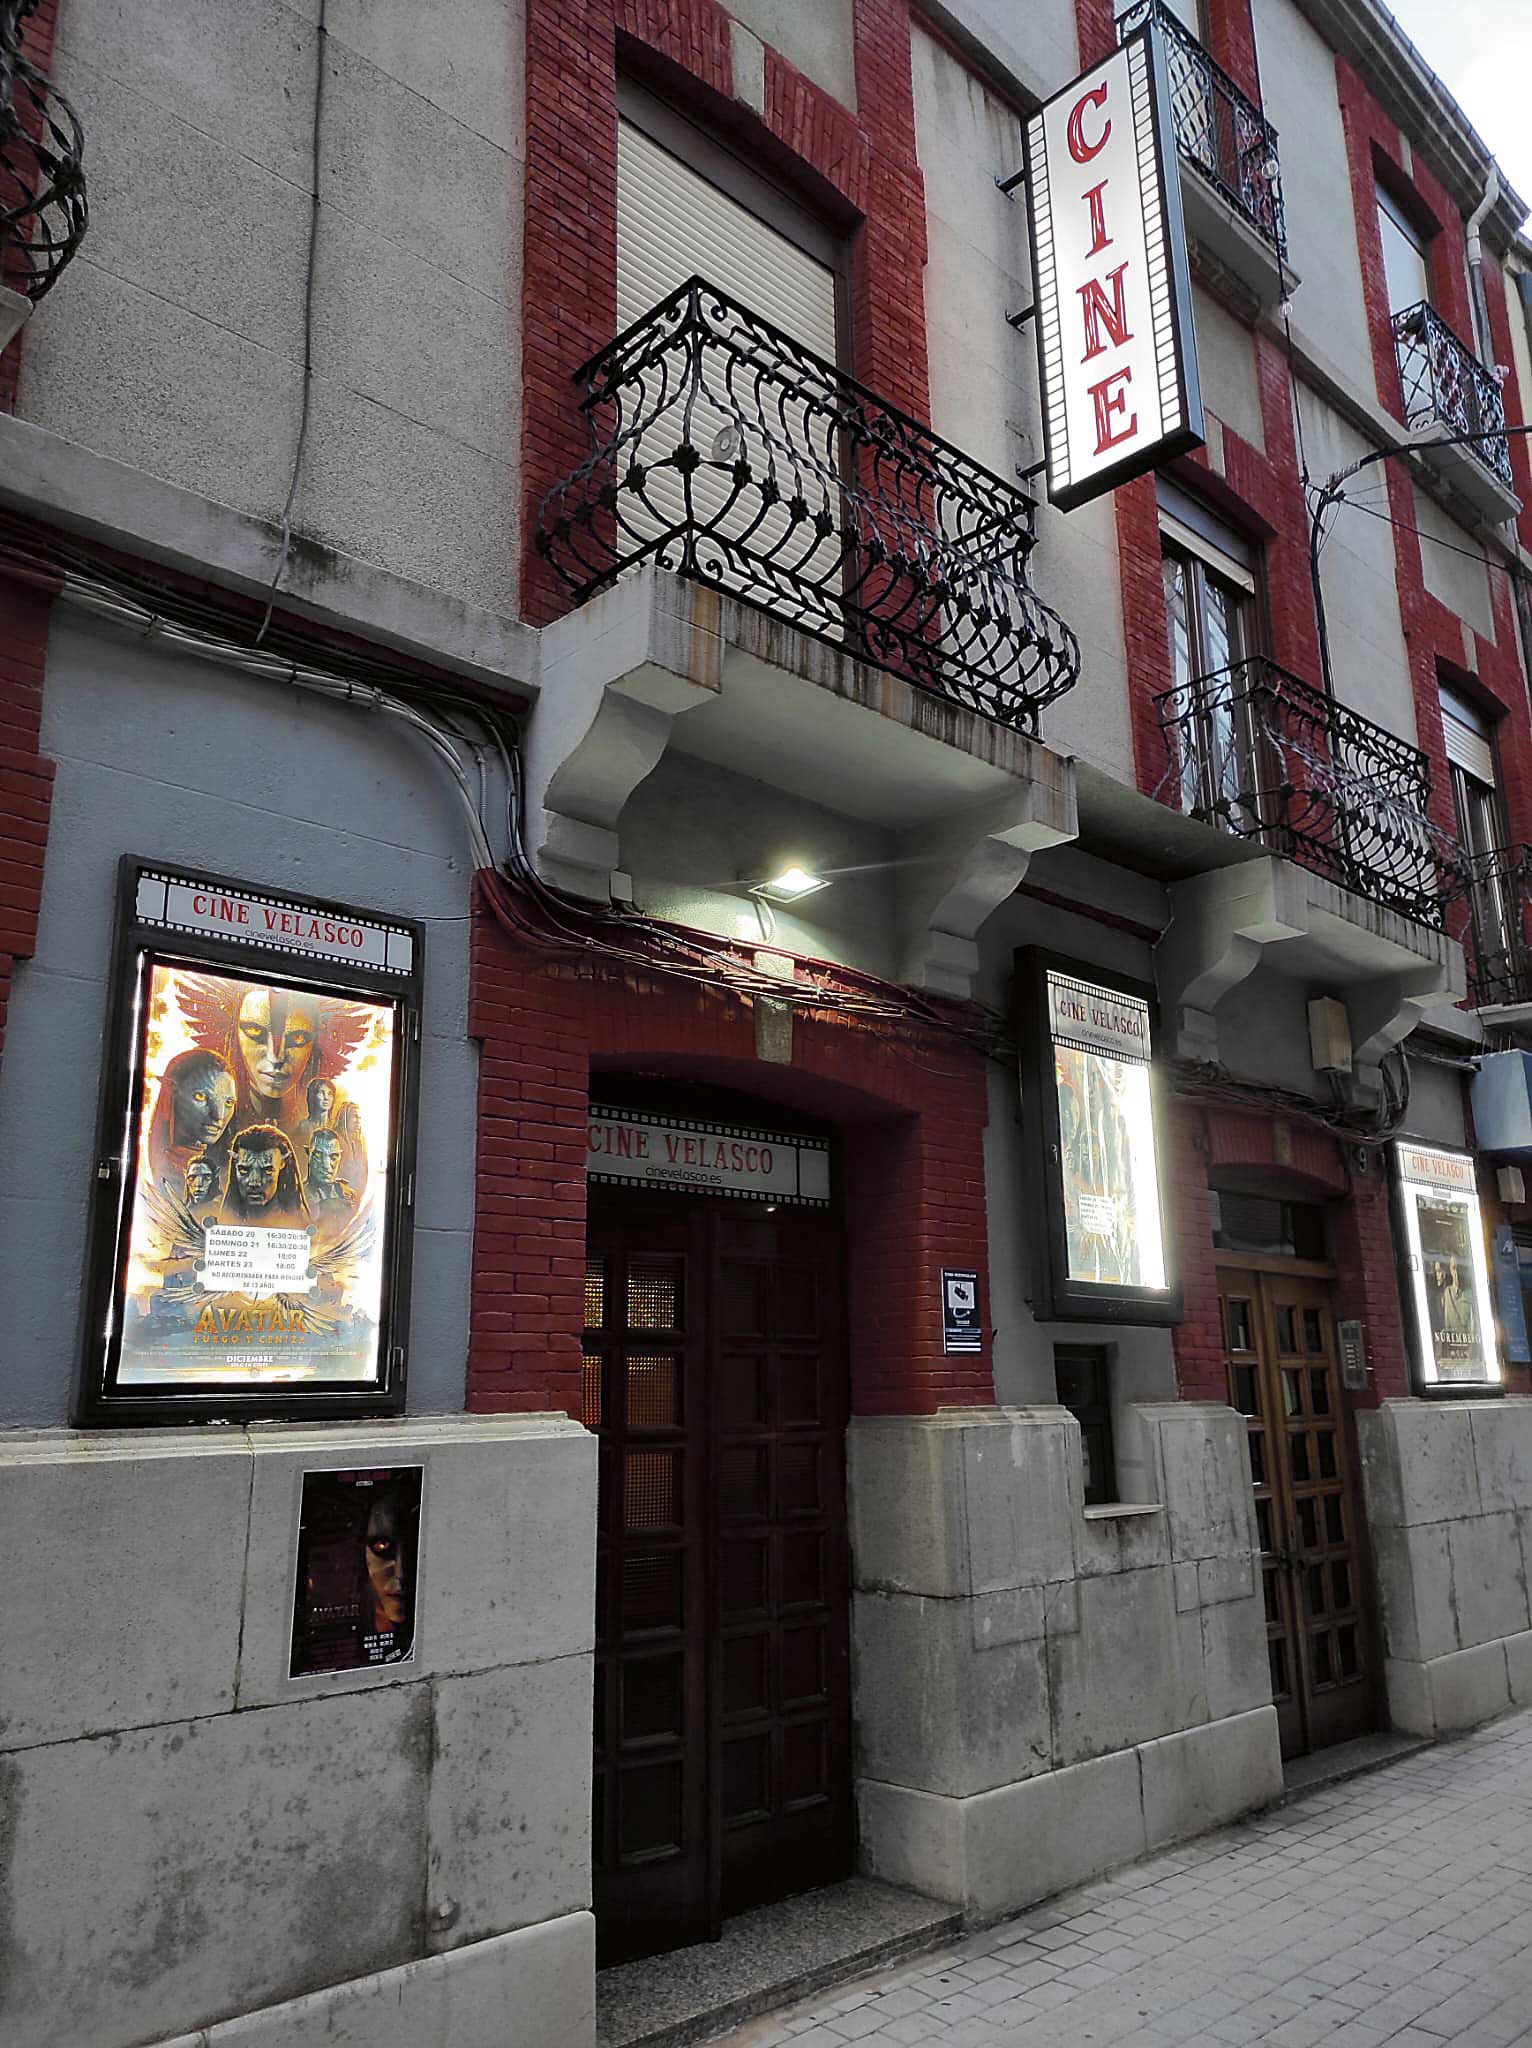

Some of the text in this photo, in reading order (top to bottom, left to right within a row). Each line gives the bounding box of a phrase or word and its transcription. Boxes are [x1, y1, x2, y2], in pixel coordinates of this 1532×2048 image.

[1066, 80, 1138, 457] CINE
[193, 895, 364, 948] CINE VELASCO
[245, 929, 314, 949] cinevelasco.es
[1060, 1000, 1140, 1037] CINE VELASCO
[588, 1124, 773, 1174] CINE VELASCO
[645, 1165, 722, 1185] cinevelasco.es
[1412, 1155, 1464, 1179] CINE VELASCO
[210, 1239, 248, 1247] DOMINGO
[192, 1304, 308, 1333] AVATAR
[193, 1335, 239, 1344] FUEGO
[246, 1335, 252, 1344] Y
[226, 1355, 273, 1363] DICIEMBRE
